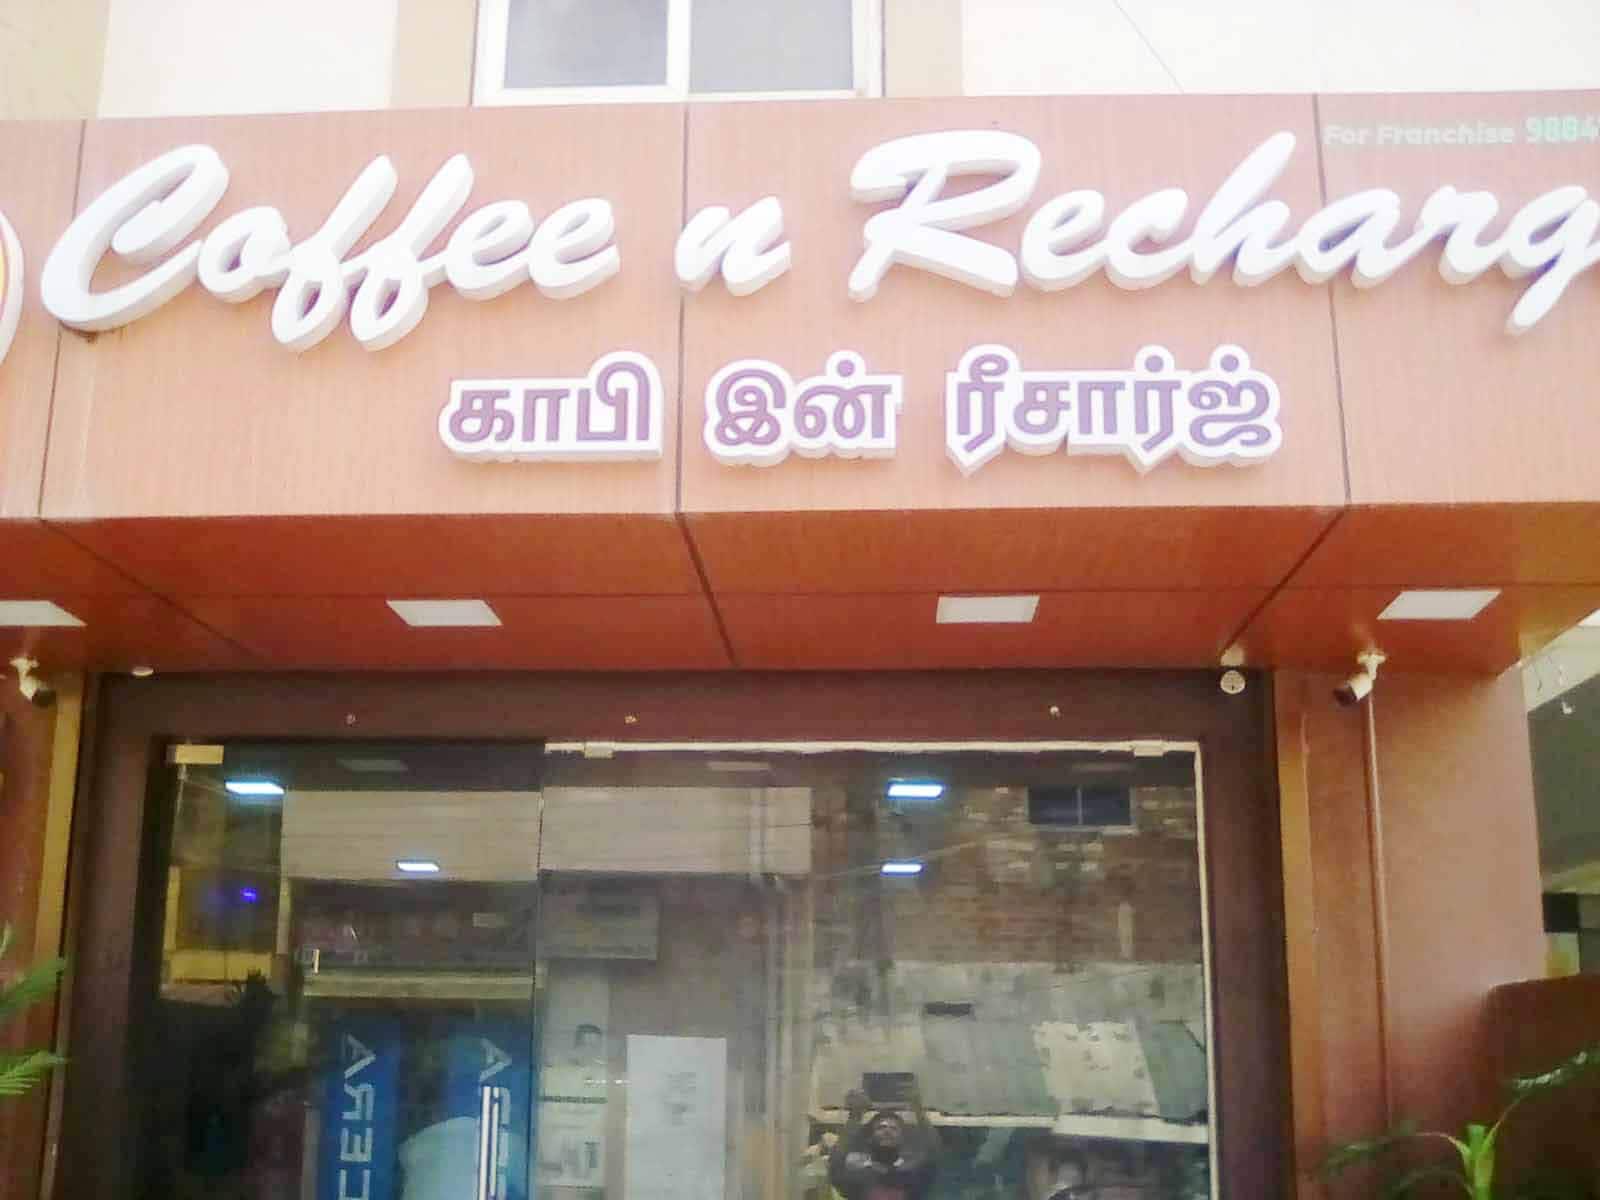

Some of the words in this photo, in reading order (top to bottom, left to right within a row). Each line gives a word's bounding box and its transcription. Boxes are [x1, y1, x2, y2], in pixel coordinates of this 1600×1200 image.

[1323, 124, 1370, 145] For
[1377, 119, 1516, 145] Franchise
[1524, 114, 1600, 143] 9884
[41, 144, 620, 351] Coffee
[675, 196, 791, 298] n
[448, 360, 651, 443] காபி
[714, 358, 893, 447] இன்
[956, 353, 1272, 453] ரீசார்ஜ்
